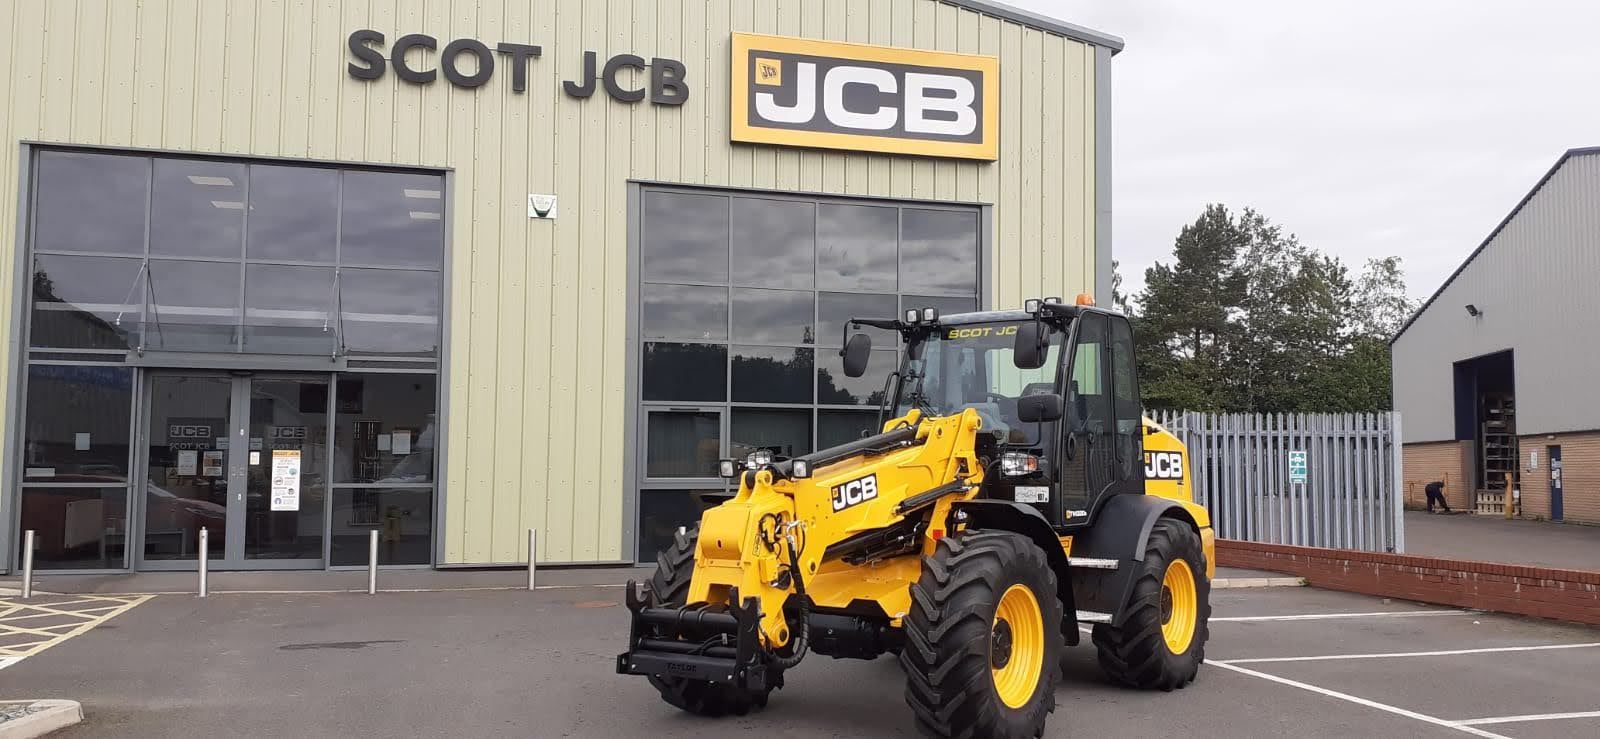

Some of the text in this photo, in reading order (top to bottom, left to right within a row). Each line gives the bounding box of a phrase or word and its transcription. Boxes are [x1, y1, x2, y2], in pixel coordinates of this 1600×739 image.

[348, 29, 690, 105] SCOT JCB
[755, 62, 977, 136] JCB
[948, 325, 1018, 339] SCOT JC
[172, 426, 210, 437] JCB
[272, 427, 306, 438] JCB
[1144, 452, 1183, 478] JCB
[833, 475, 878, 511] JCB
